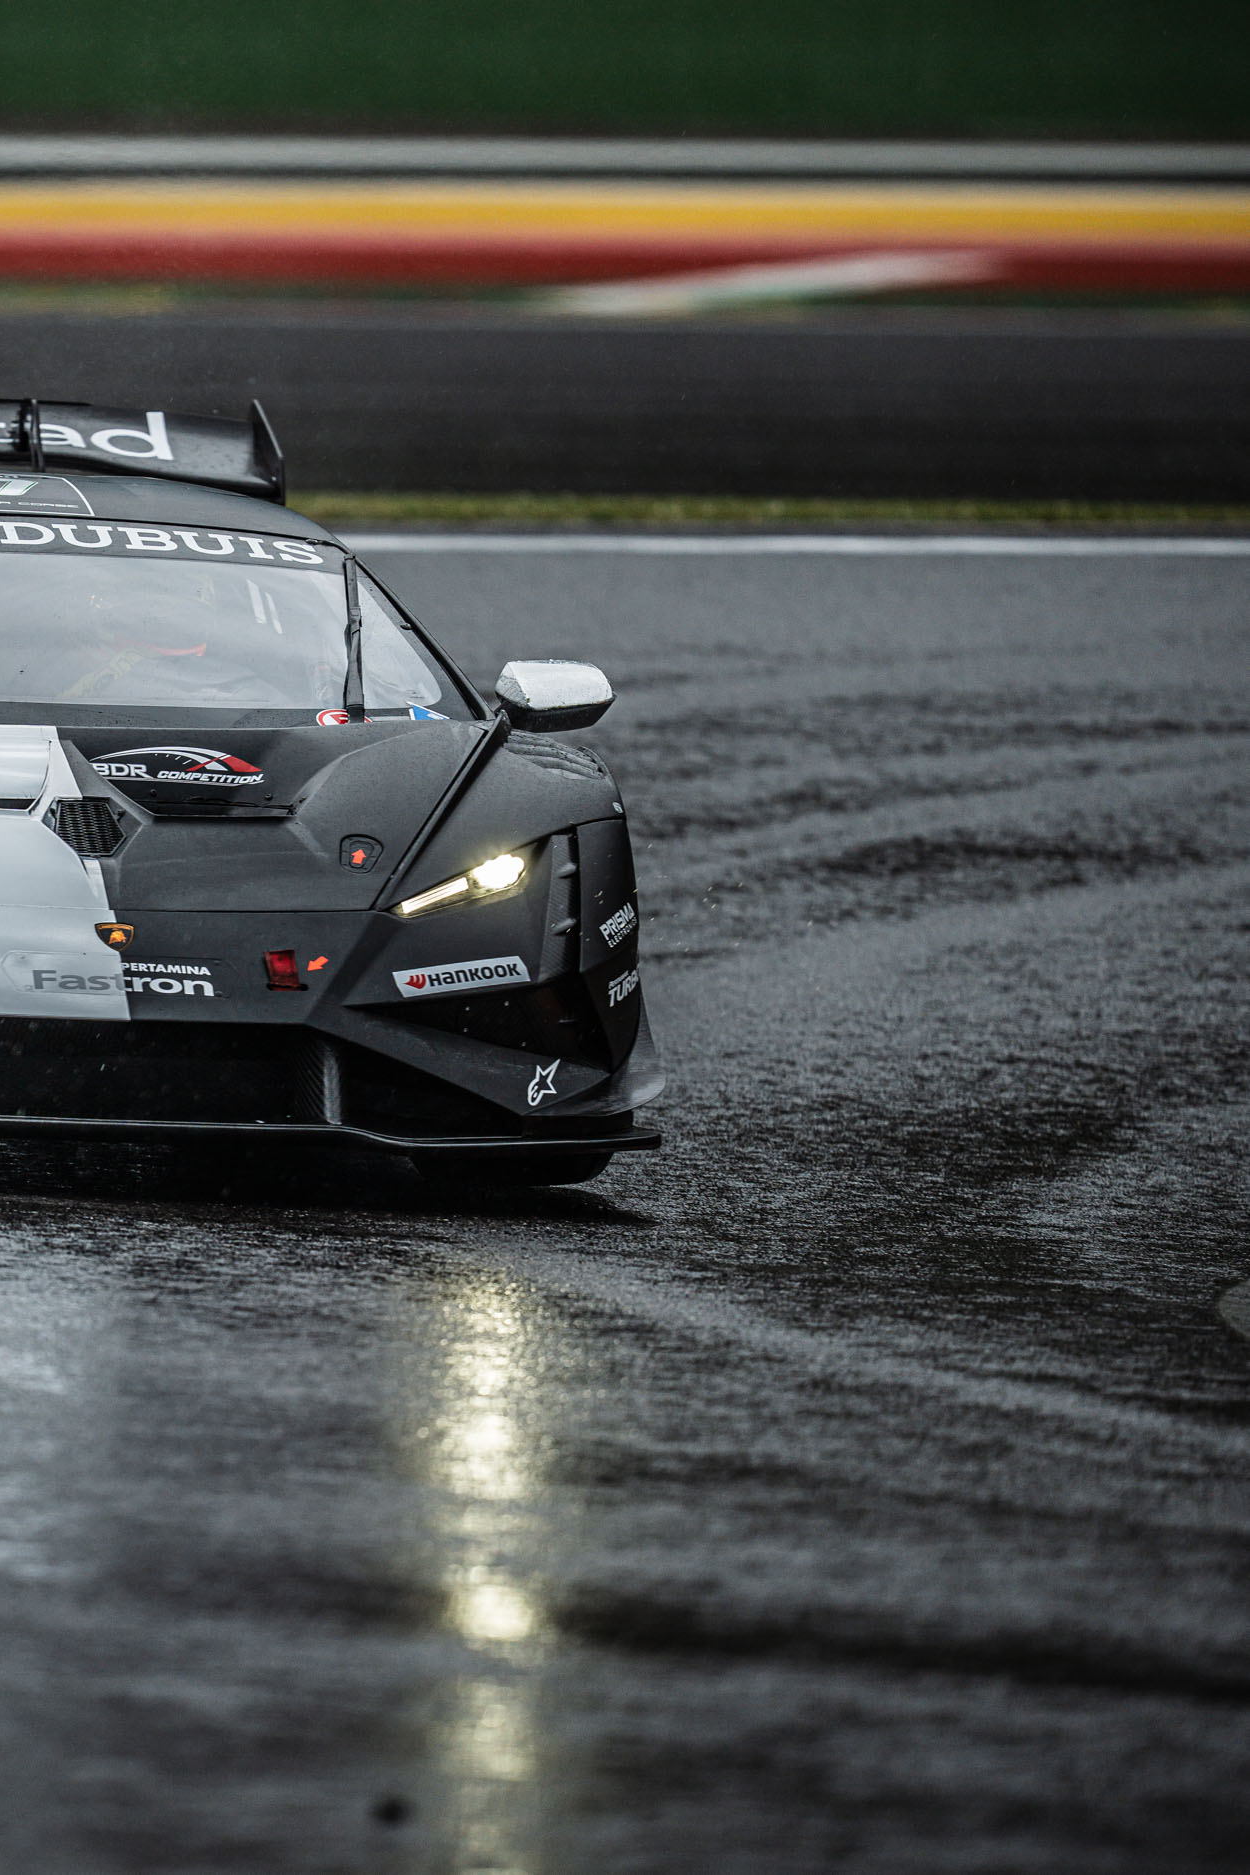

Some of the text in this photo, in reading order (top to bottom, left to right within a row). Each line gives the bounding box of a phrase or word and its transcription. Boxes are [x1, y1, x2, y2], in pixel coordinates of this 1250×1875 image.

[92, 763, 263, 785] BDR COMPETITION
[599, 902, 636, 941] PRISMA
[121, 962, 211, 976] PERTAMINA
[32, 969, 215, 997] Fastron
